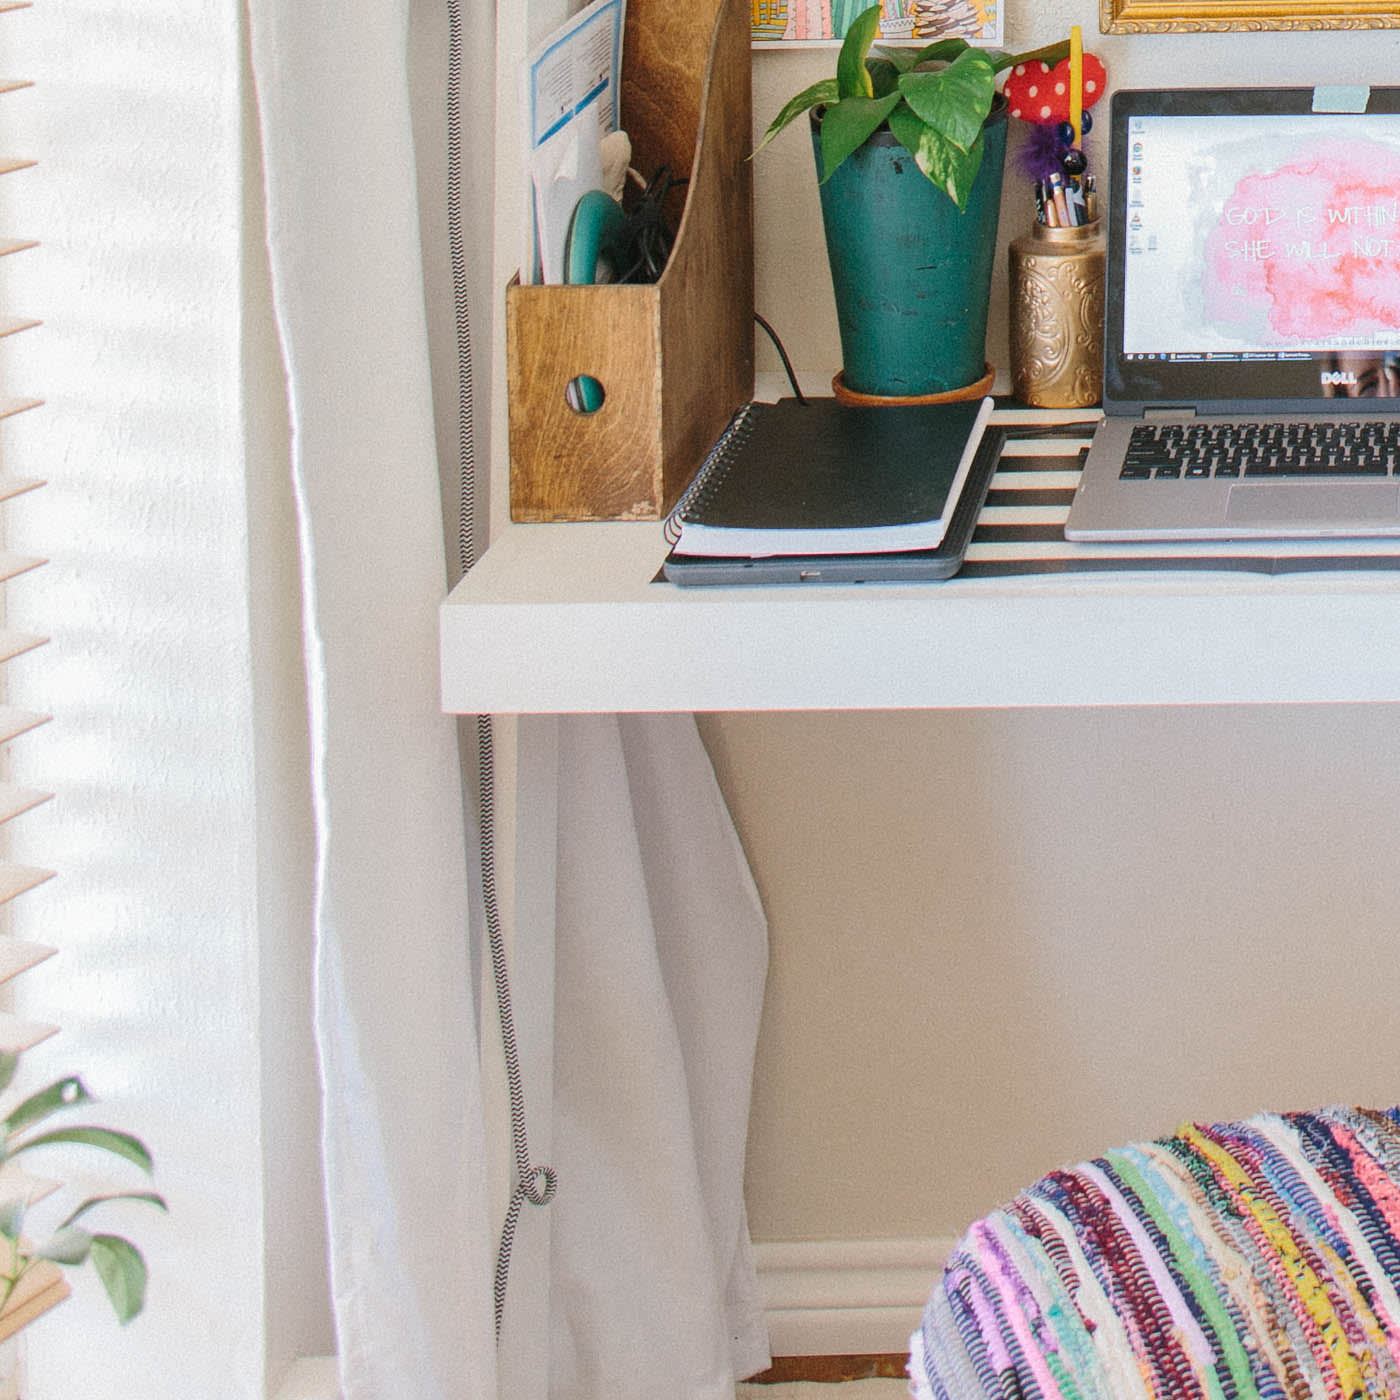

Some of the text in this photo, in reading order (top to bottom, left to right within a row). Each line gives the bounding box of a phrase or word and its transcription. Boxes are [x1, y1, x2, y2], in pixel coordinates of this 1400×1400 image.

[1226, 207, 1287, 226] GOD
[1296, 205, 1317, 227] IS
[1328, 203, 1398, 227] WITHIN
[1224, 240, 1276, 262] SHE
[1286, 240, 1342, 260] WILL
[1352, 238, 1395, 258] NOT
[1320, 371, 1358, 387] DELL
